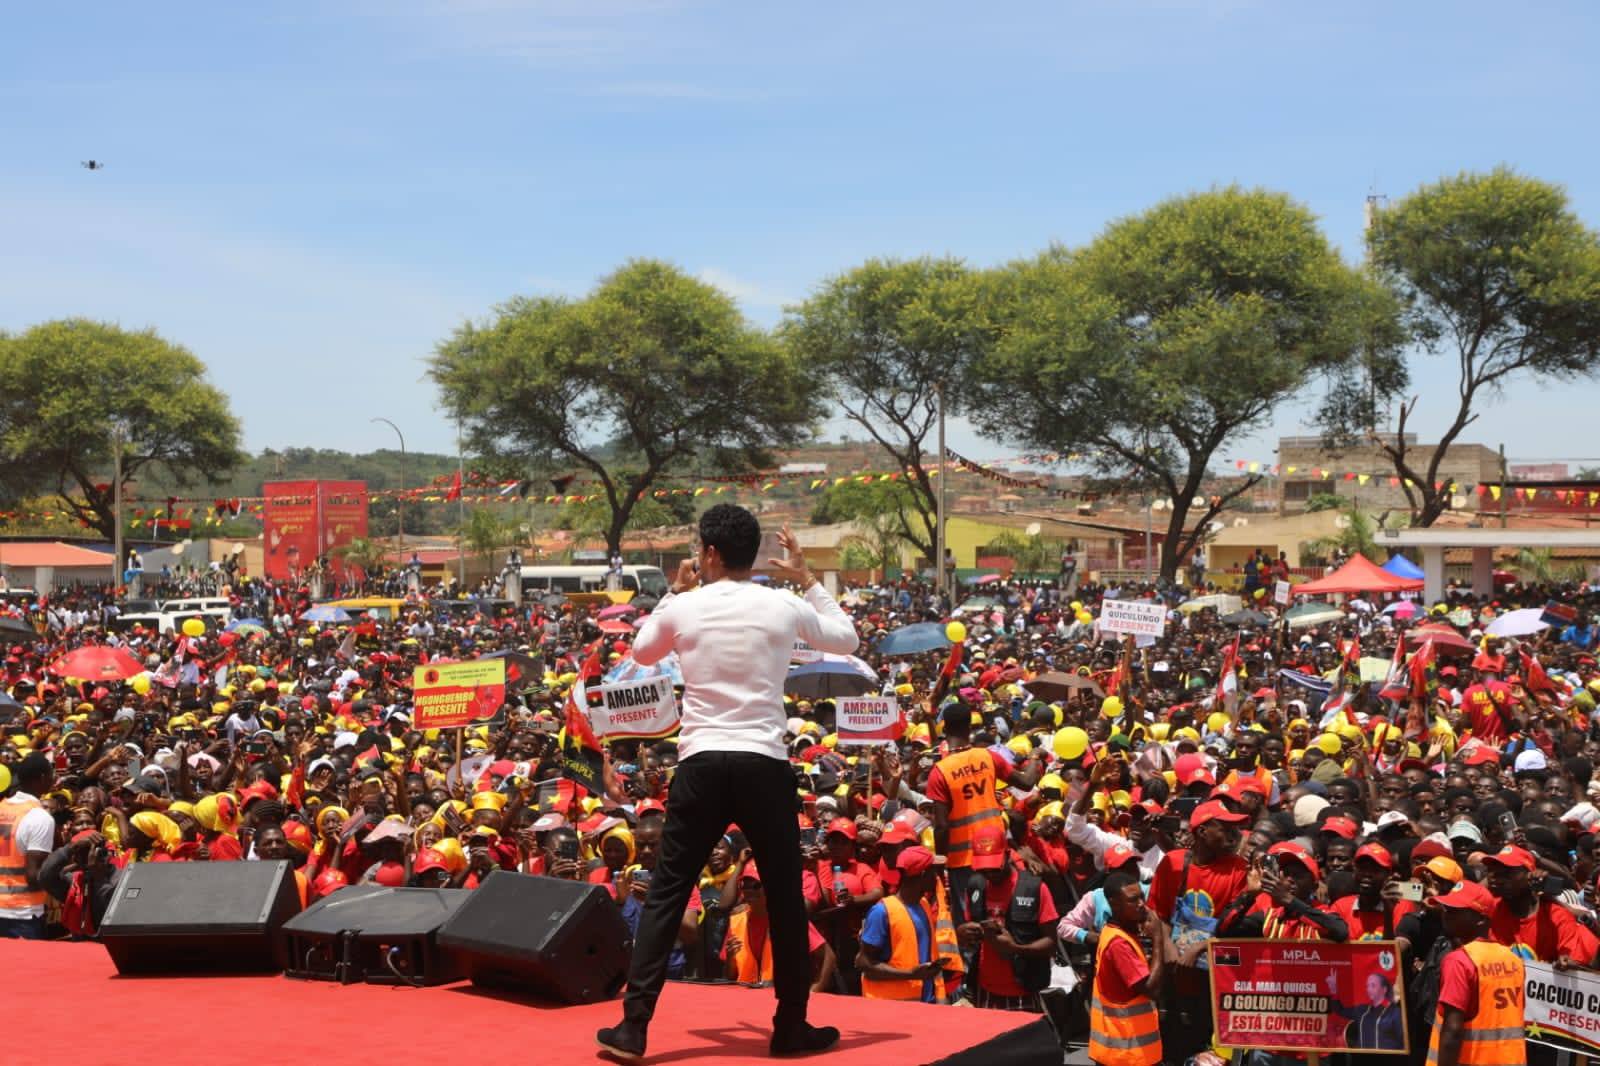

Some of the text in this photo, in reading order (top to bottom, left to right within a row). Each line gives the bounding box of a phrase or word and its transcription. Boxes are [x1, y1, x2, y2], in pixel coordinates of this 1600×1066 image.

[1108, 610, 1160, 623] QUICULUNGO
[1108, 620, 1156, 632] PRESENTE
[606, 684, 660, 710] AMBACA
[422, 702, 467, 717] PRESENTE
[608, 707, 657, 725] PRESENTE
[843, 701, 889, 715] AMBACA
[848, 715, 883, 725] PRESENTE
[951, 760, 988, 780] MPLA
[962, 778, 987, 800] SV
[1282, 949, 1321, 961] MPLA
[1255, 981, 1282, 992] MARA
[1283, 981, 1317, 993] QUIOSA
[1527, 980, 1584, 1011] CACULO
[1223, 994, 1328, 1013] O GOLUNGO ALTO
[1493, 986, 1521, 1009] SV
[1231, 1013, 1323, 1033] ESTÁ CONTIGO
